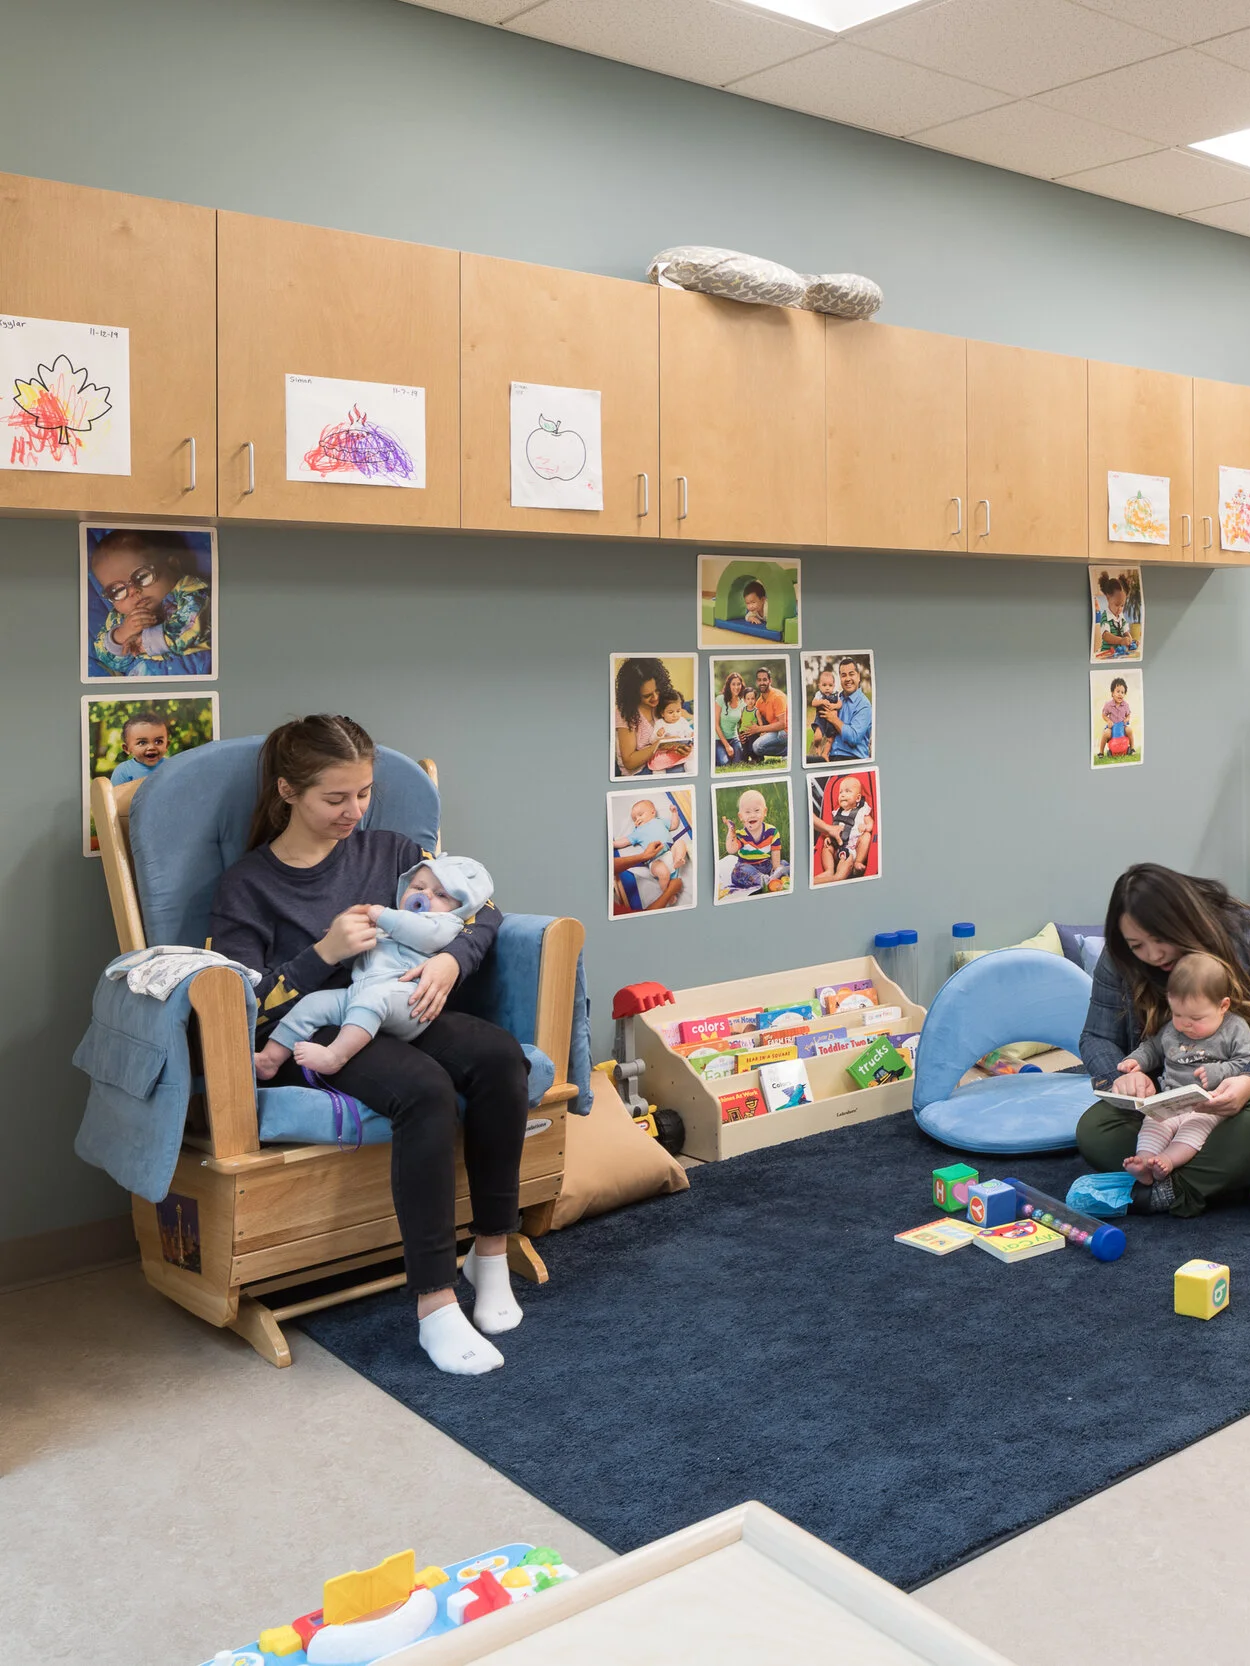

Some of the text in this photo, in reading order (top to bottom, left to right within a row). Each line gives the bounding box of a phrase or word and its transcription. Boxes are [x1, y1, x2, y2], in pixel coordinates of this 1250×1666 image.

[89, 327, 119, 339] 11-12-19
[691, 1021, 726, 1034] colors
[818, 1041, 850, 1056] Toddler
[850, 1039, 867, 1049] Two
[858, 1044, 889, 1075] trucks
[936, 1179, 945, 1203] H
[971, 1204, 983, 1218] Y
